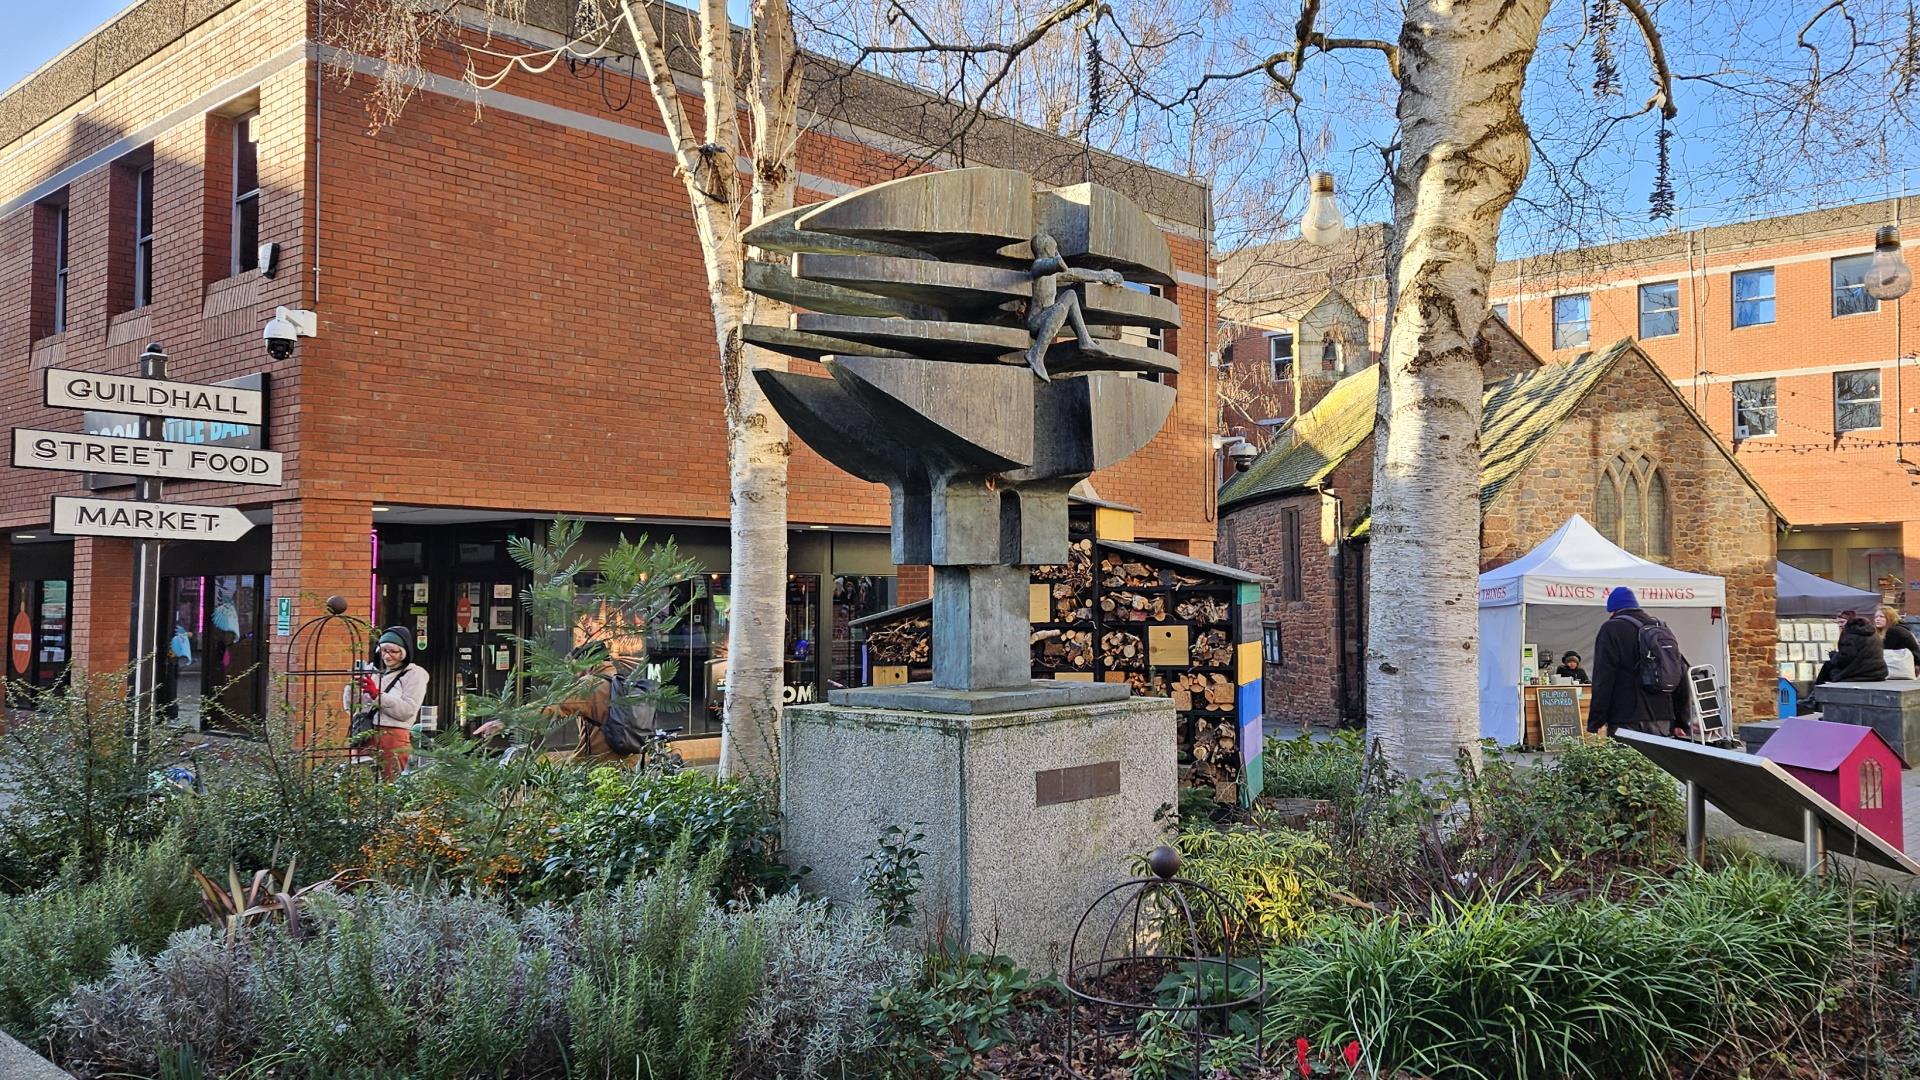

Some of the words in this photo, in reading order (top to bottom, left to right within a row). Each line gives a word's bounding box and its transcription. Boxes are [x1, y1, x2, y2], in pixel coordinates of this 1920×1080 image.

[65, 378, 248, 415] GUILDHALL
[33, 438, 173, 467] STREET
[188, 451, 270, 475] FOOD
[76, 506, 220, 532] MARKET
[1481, 586, 1507, 601] THINGS
[1545, 584, 1595, 599] WINGS
[1639, 587, 1696, 600] THINGS
[1547, 726, 1576, 736] STUDENT
